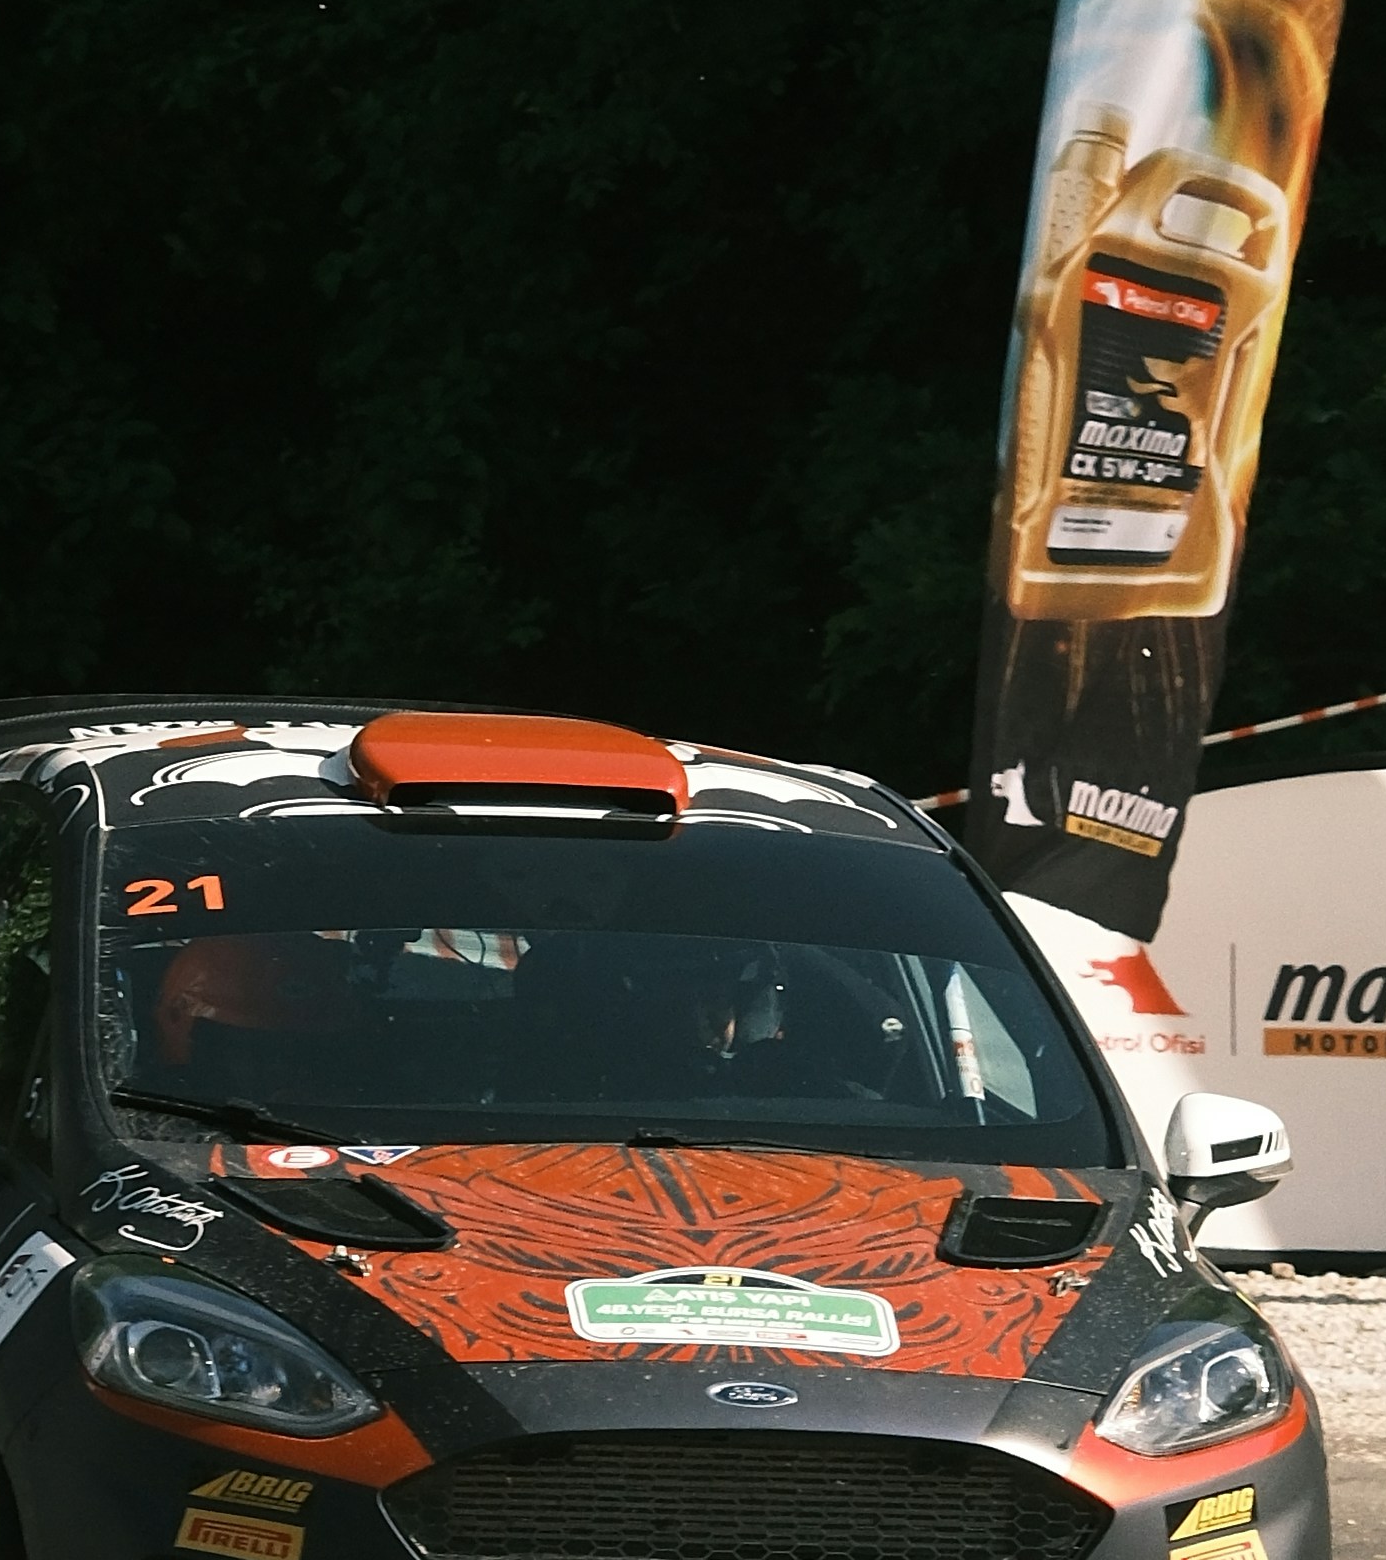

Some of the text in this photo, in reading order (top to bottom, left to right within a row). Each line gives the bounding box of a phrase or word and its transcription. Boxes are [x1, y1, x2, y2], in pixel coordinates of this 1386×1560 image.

[124, 875, 224, 916] 21
[1095, 1034, 1142, 1053] trol
[702, 1273, 743, 1287] 21
[700, 1306, 780, 1320] BURSA
[230, 1470, 313, 1503] BRIG
[1199, 1487, 1255, 1520] BRIG
[186, 1517, 293, 1559] PIRELLI
